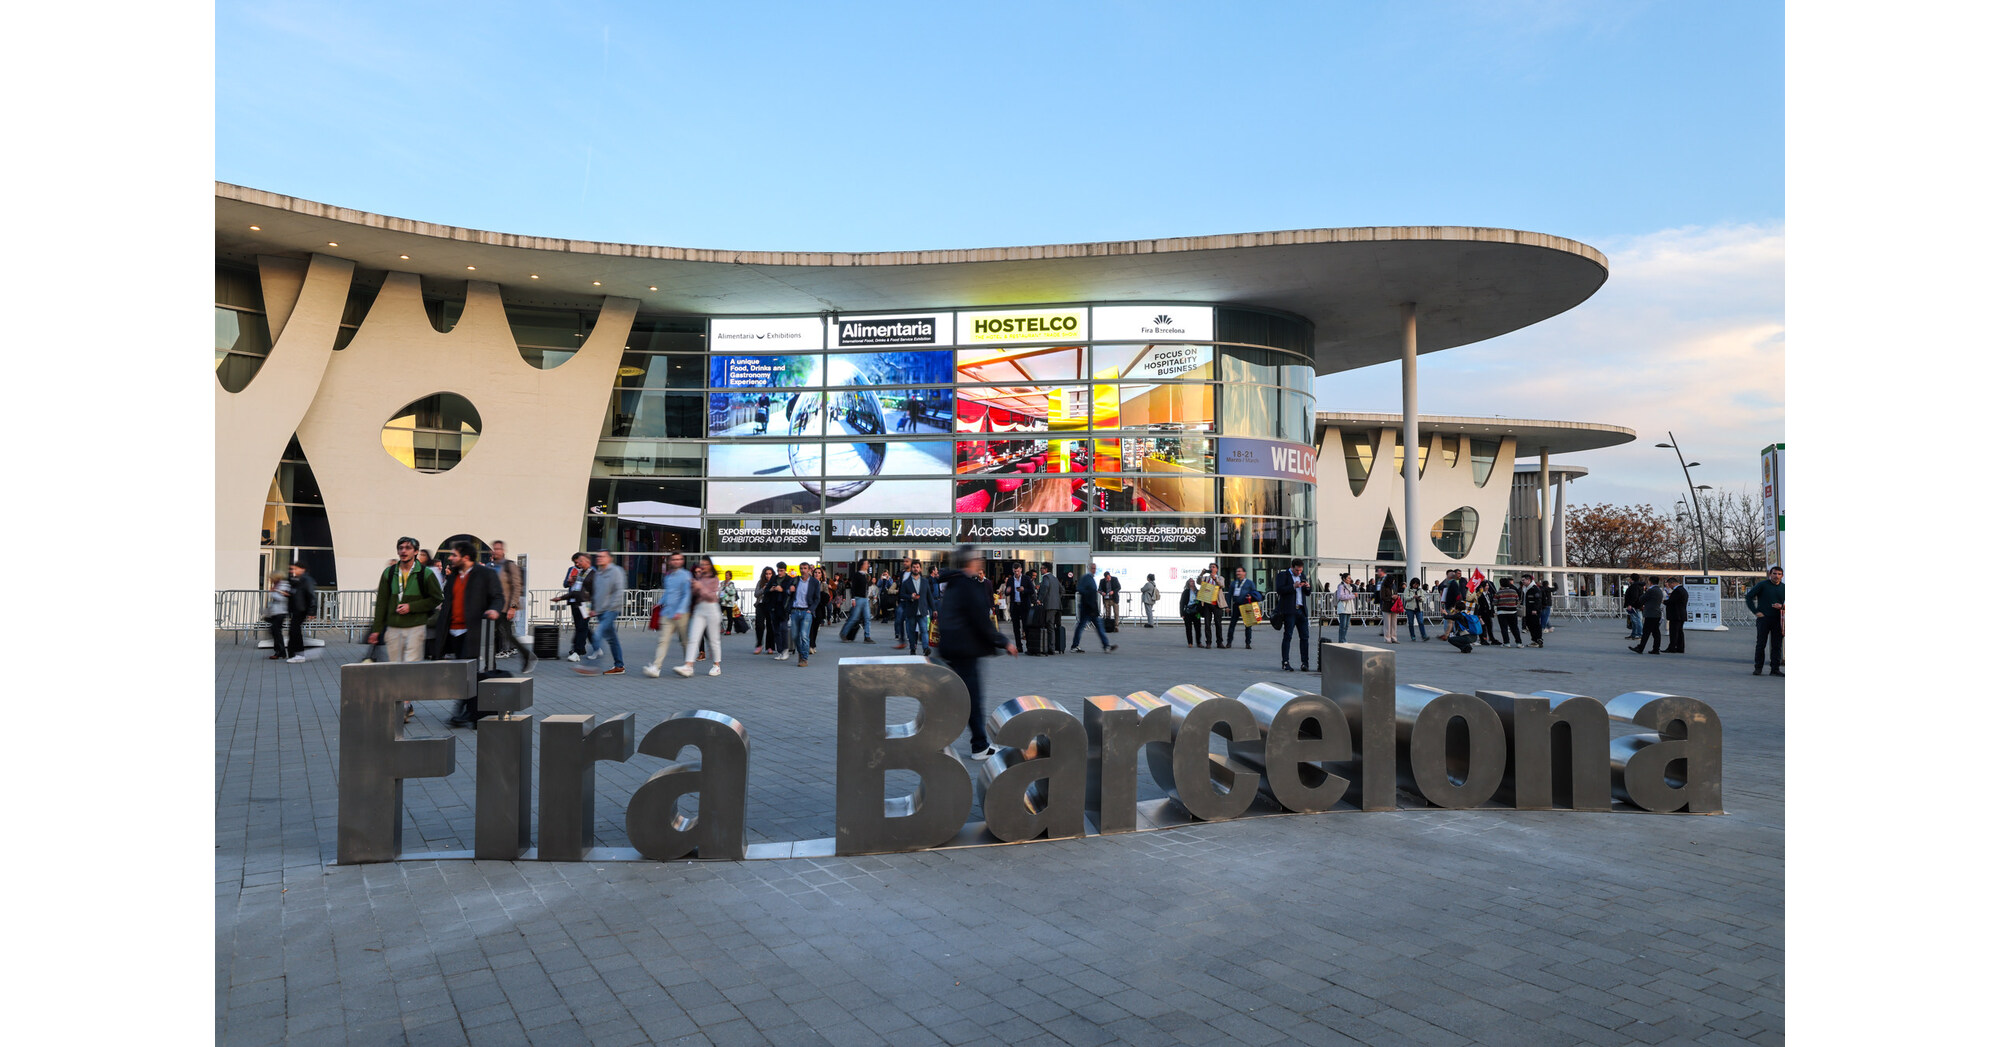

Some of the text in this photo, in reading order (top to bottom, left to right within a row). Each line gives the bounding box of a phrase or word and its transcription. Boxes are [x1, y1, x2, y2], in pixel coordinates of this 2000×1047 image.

[842, 321, 931, 338] Alimentaria
[975, 316, 1077, 333] HOSTELCO
[1154, 348, 1197, 360] FOCUS ON
[1144, 356, 1198, 370] HOSPITALITY
[1157, 364, 1198, 376] BUSINESS
[1232, 450, 1253, 458] 18-21
[718, 528, 812, 536] EXPOSITORES Y PRENSA
[848, 524, 1049, 537] Accés / Acceso / Access SUD
[1100, 527, 1207, 535] VISITANTES ACREDITADOS
[1110, 535, 1197, 543] REGISTERED VISITORS
[337, 643, 1724, 865] Fira Barcelona
